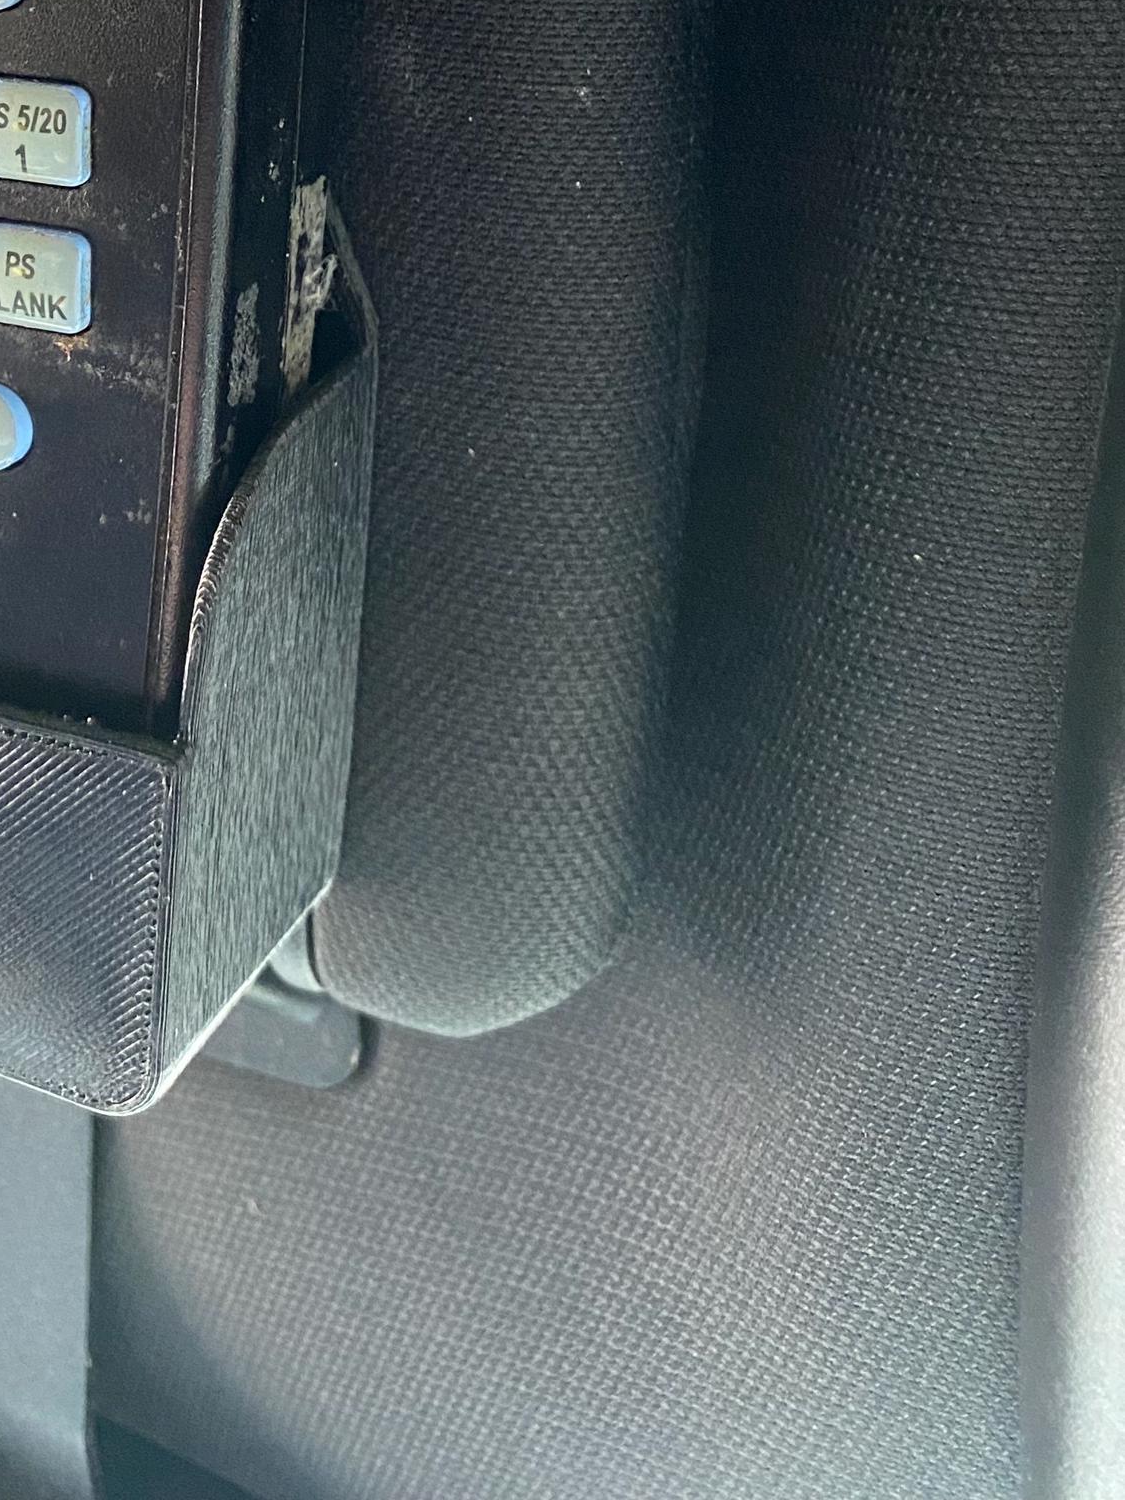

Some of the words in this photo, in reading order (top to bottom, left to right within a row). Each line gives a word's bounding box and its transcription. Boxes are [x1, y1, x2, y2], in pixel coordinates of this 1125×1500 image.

[17, 104, 67, 135] 5/20
[15, 143, 28, 173] 1
[5, 250, 35, 280] PS
